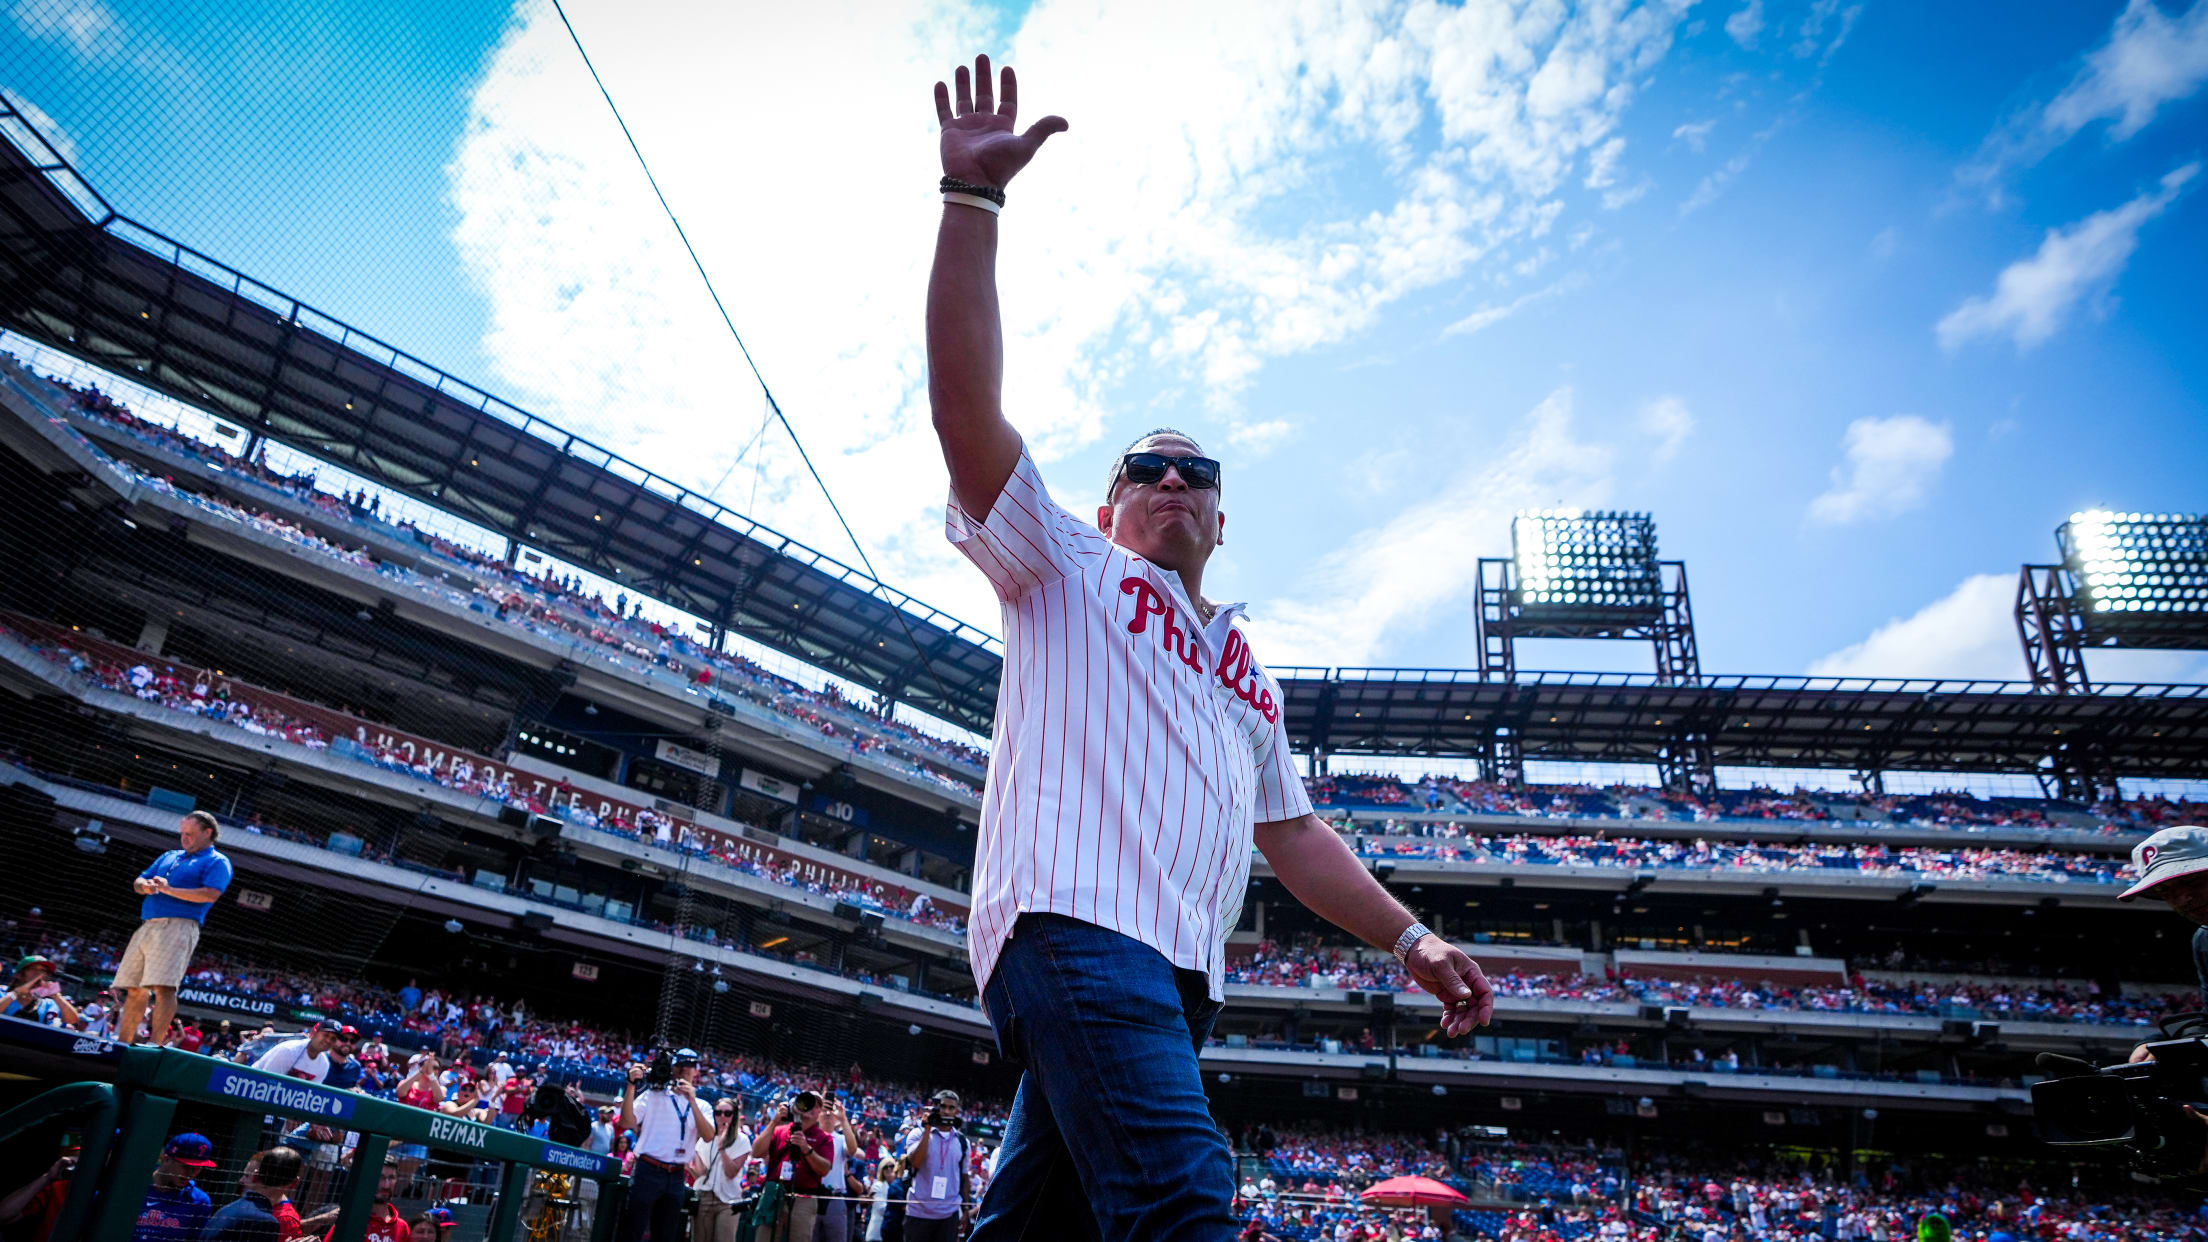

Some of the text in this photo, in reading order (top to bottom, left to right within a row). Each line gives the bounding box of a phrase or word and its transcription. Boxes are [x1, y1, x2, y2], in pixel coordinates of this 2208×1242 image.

[1119, 576, 1279, 725] Phillie
[836, 802, 853, 821] 10
[791, 859, 884, 895] PHILLIS
[229, 996, 275, 1014] CLUB
[223, 1075, 330, 1114] smartwater
[429, 1117, 489, 1149] RE/MAX
[548, 1149, 596, 1171] smartwater
